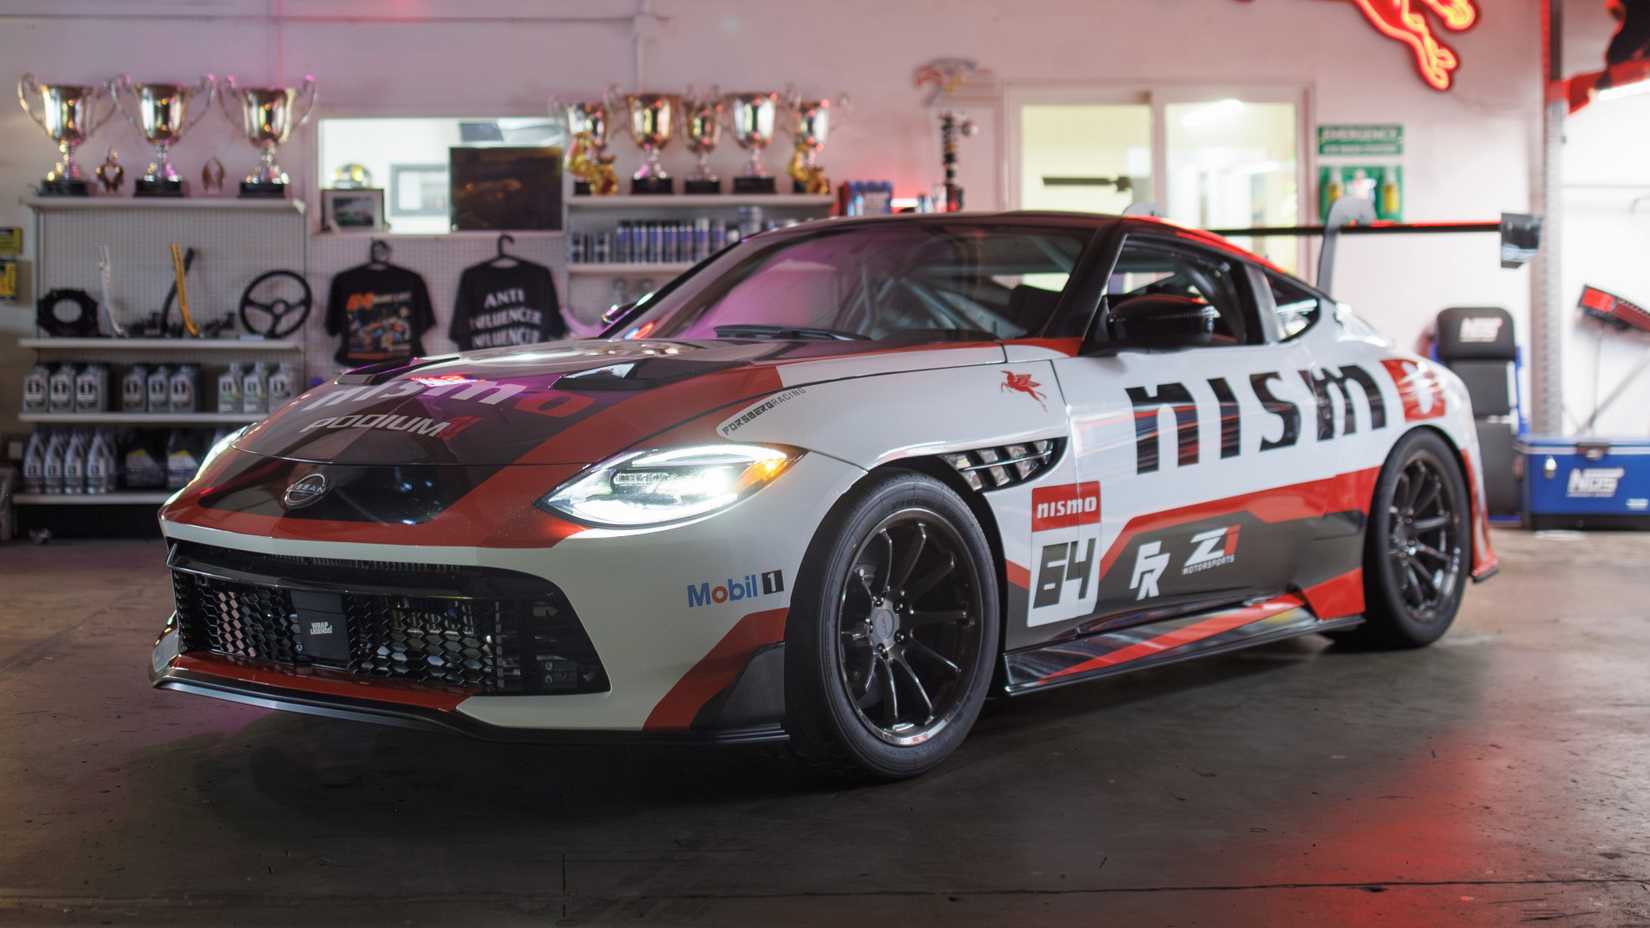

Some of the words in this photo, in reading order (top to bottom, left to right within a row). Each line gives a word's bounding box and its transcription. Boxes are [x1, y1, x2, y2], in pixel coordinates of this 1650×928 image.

[484, 288, 525, 308] ANTI
[1124, 358, 1446, 475] nismo
[1036, 496, 1097, 519] nismo
[687, 574, 758, 608] Mobil
[764, 571, 782, 594] 1
[1033, 537, 1097, 609] 64
